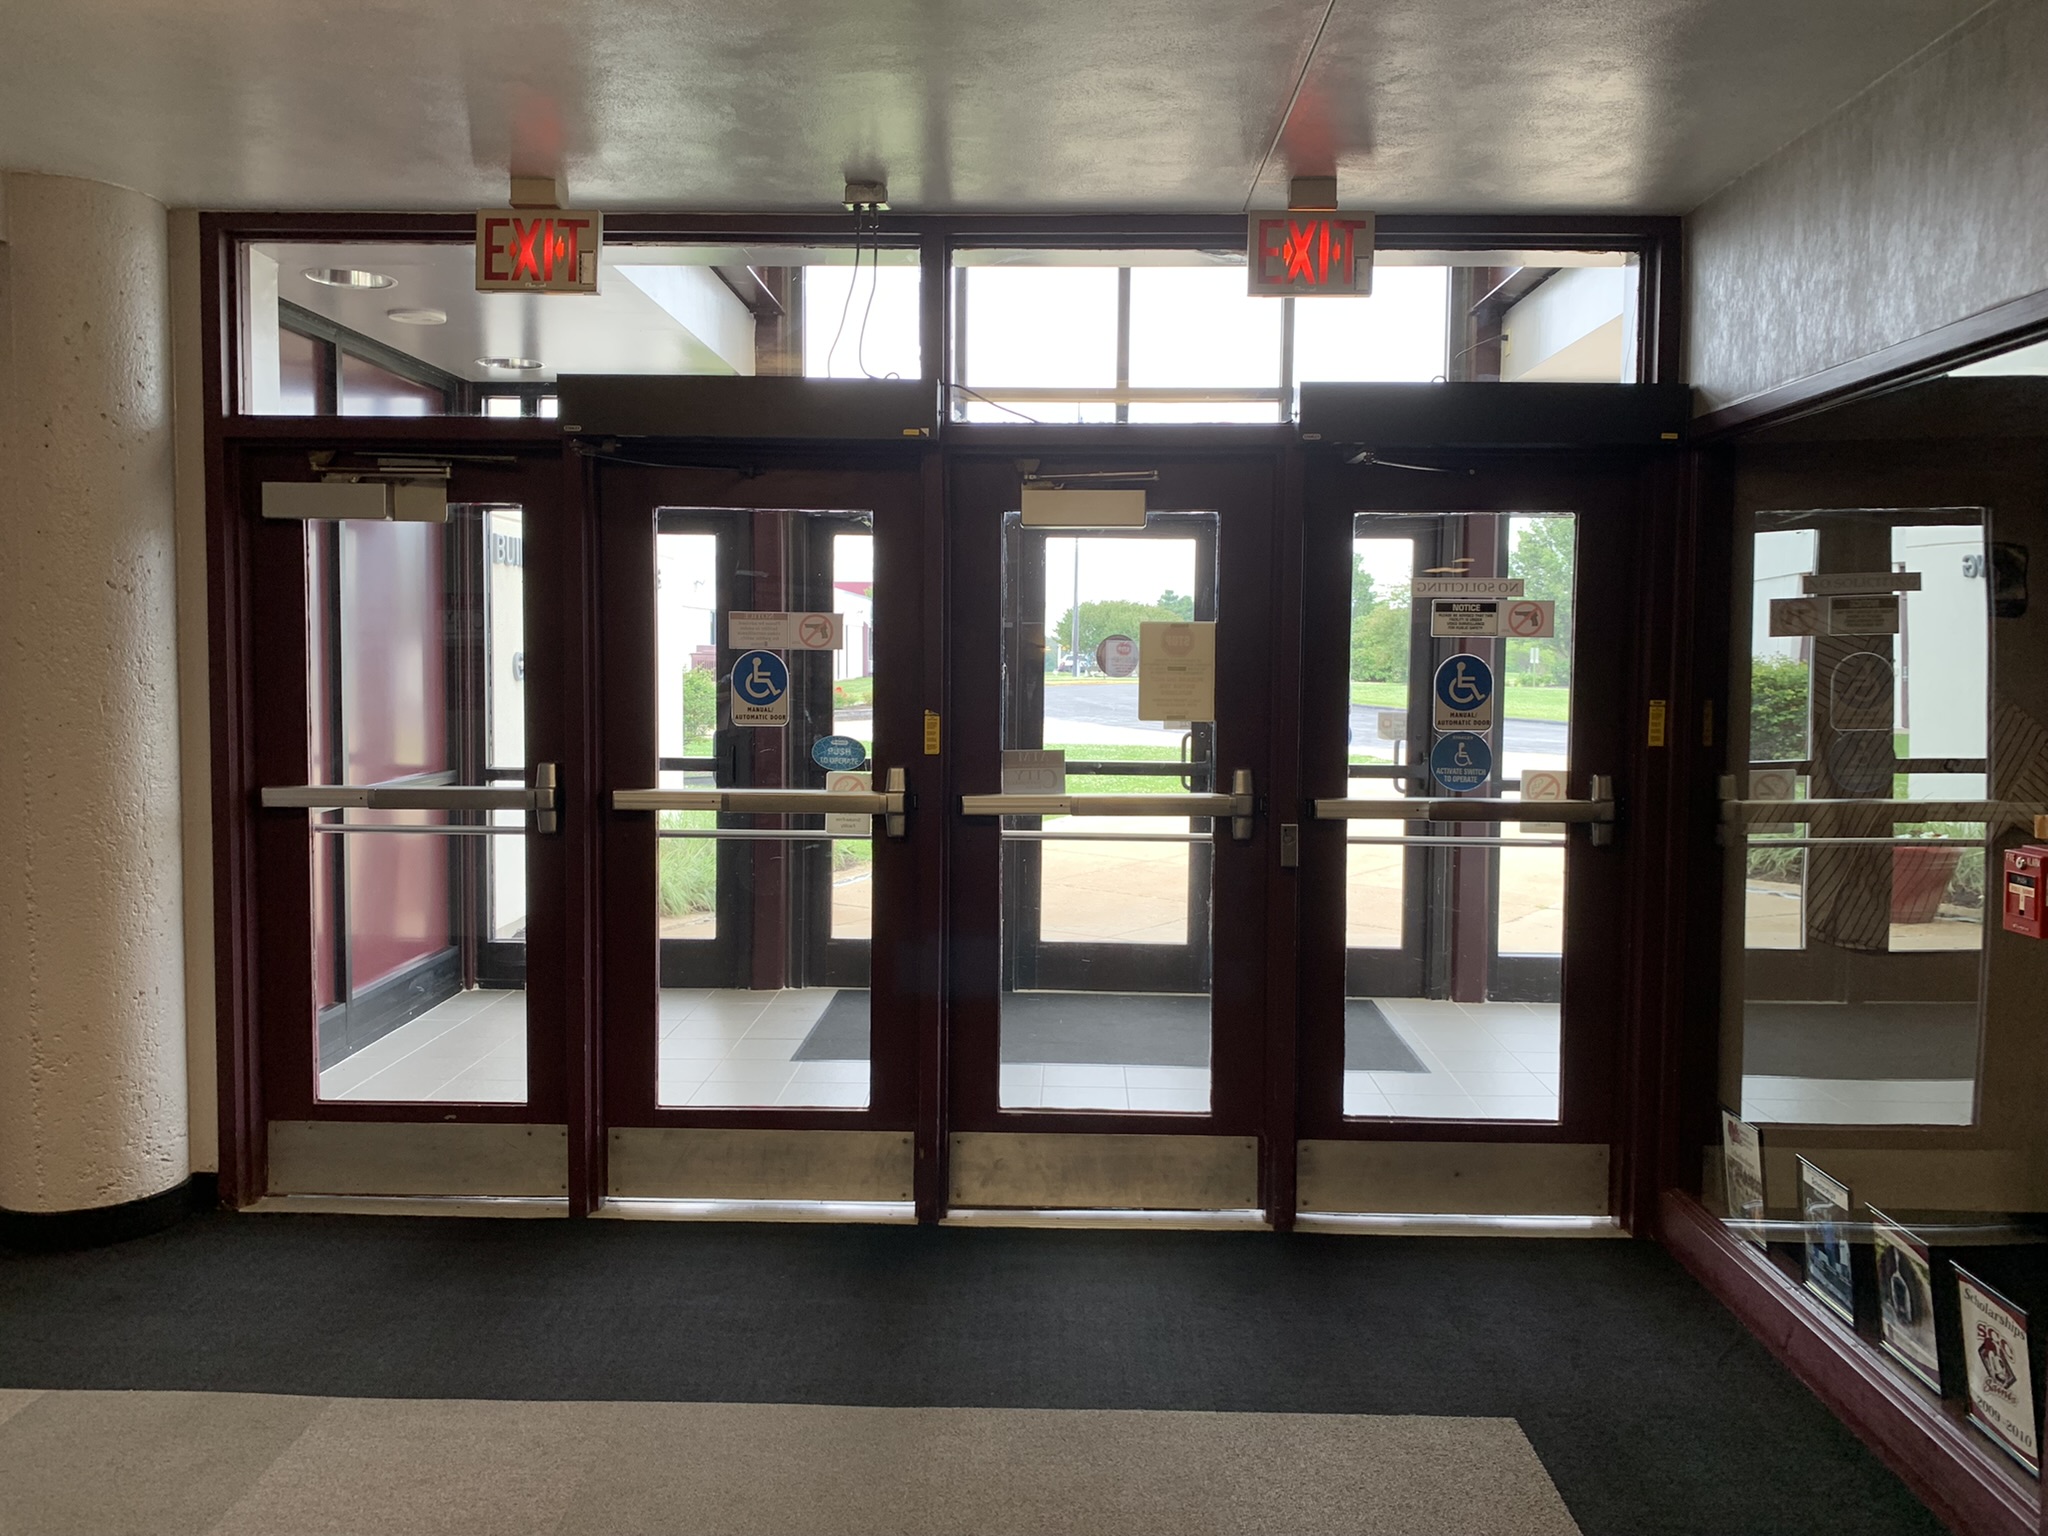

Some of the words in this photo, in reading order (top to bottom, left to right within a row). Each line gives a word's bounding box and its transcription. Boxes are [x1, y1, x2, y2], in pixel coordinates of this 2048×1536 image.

[484, 218, 590, 282] EXIT
[1258, 219, 1367, 285] EXIT
[1452, 603, 1481, 612] NOTICE
[827, 747, 852, 755] PUSH
[1436, 767, 1463, 775] ACTIVATE
[1464, 768, 1487, 776] SWITCH
[1444, 775, 1452, 783] TO
[1964, 1288, 2026, 1341] Scholarships
